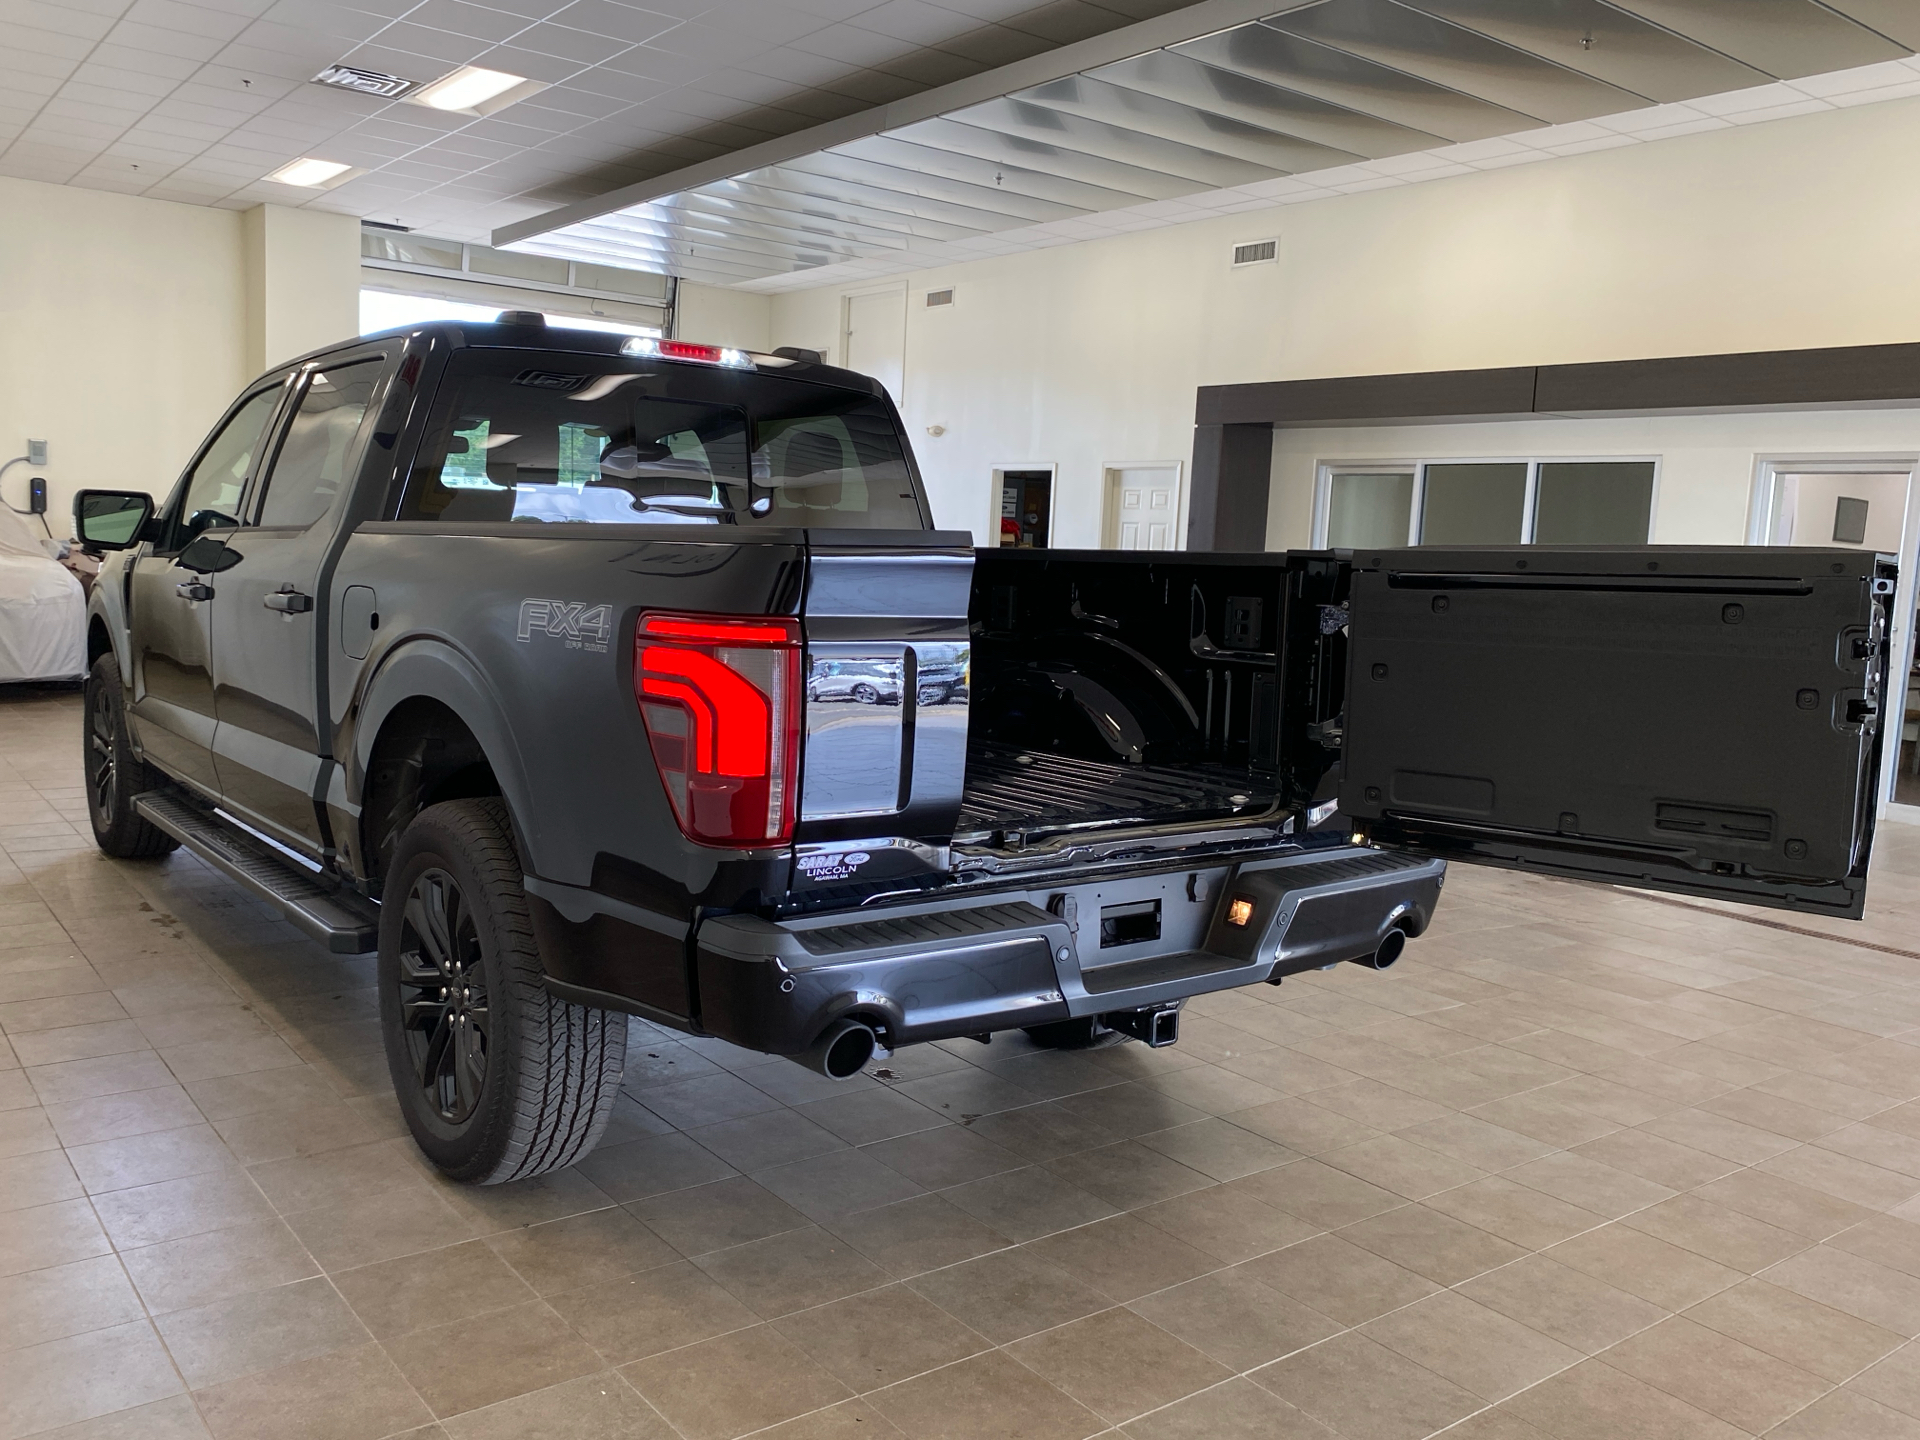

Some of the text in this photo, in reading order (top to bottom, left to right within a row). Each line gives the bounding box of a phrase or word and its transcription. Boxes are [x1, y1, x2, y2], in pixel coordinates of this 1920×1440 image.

[516, 598, 613, 644] FX4
[797, 853, 867, 869] SARAT Ford
[807, 865, 857, 876] LINCOLN
